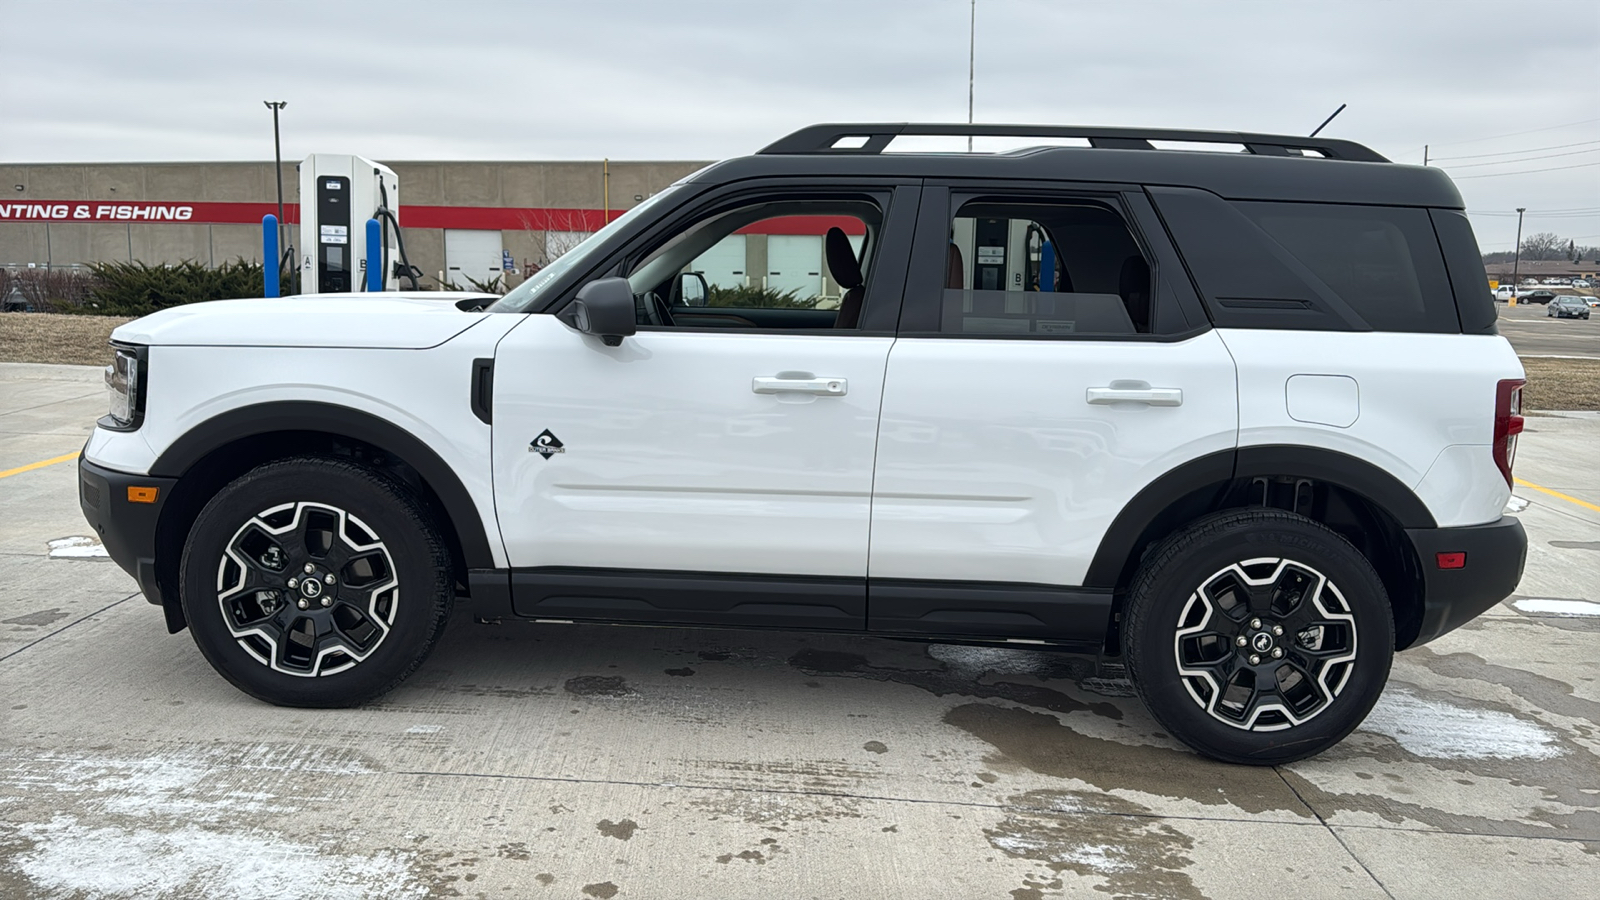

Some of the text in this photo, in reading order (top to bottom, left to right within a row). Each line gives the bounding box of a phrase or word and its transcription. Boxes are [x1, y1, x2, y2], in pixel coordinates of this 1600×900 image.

[0, 204, 193, 220] NTING & FISHING
[304, 256, 311, 265] A
[1015, 273, 1022, 282] B
